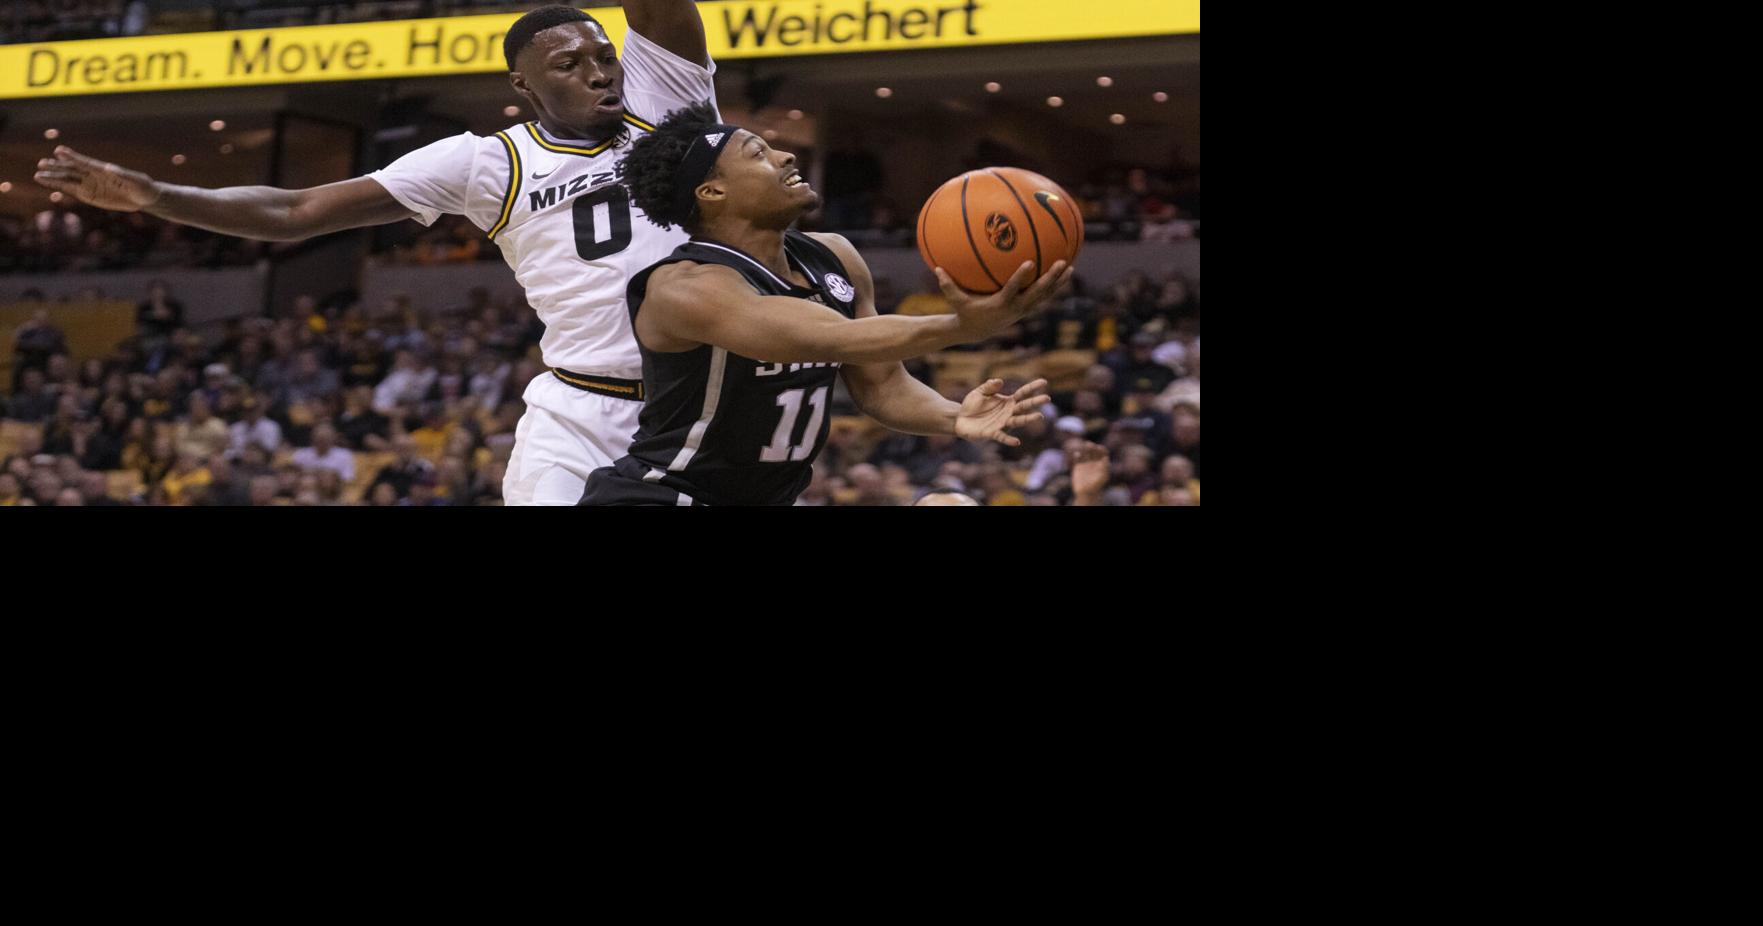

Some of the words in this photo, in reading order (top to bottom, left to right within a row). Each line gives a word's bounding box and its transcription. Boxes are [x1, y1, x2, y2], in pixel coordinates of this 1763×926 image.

[723, 0, 981, 48] Weichert
[26, 48, 202, 88] Dream.
[228, 36, 387, 76] Move.
[572, 184, 632, 261] 0
[759, 387, 828, 462] 11
